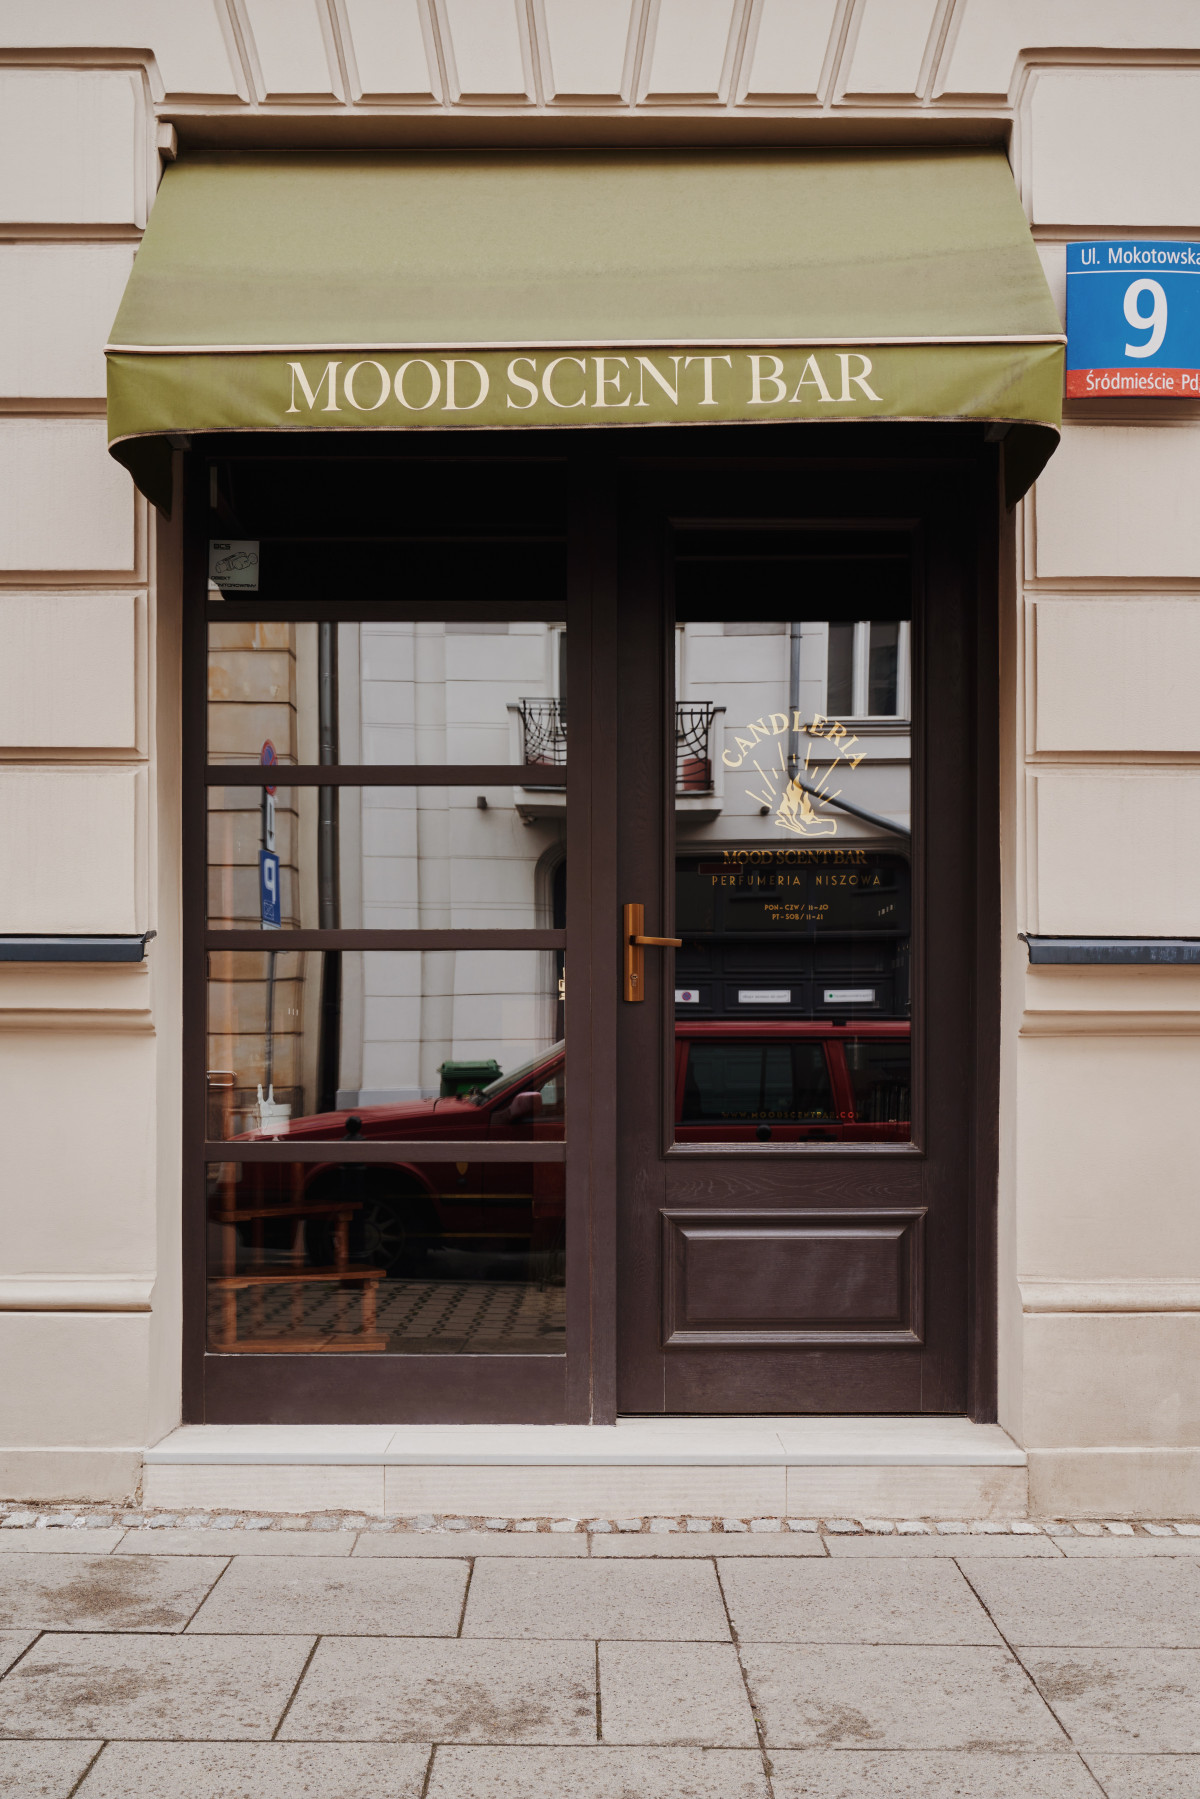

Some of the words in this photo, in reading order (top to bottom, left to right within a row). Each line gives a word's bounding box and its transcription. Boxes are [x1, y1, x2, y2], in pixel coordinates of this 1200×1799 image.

[1081, 248, 1100, 265] Ul.
[1123, 278, 1168, 358] 9
[285, 359, 490, 413] MOOD
[507, 354, 733, 410] SCENT
[746, 353, 884, 405] BAR
[1086, 370, 1174, 391] Śródmieście
[722, 711, 868, 770] CANDLERIA
[722, 850, 774, 865] MOOD
[776, 850, 832, 865] SCENT
[833, 849, 869, 865] BAR
[711, 875, 801, 886] PERFUMERIA
[815, 875, 881, 886] NISZOWA
